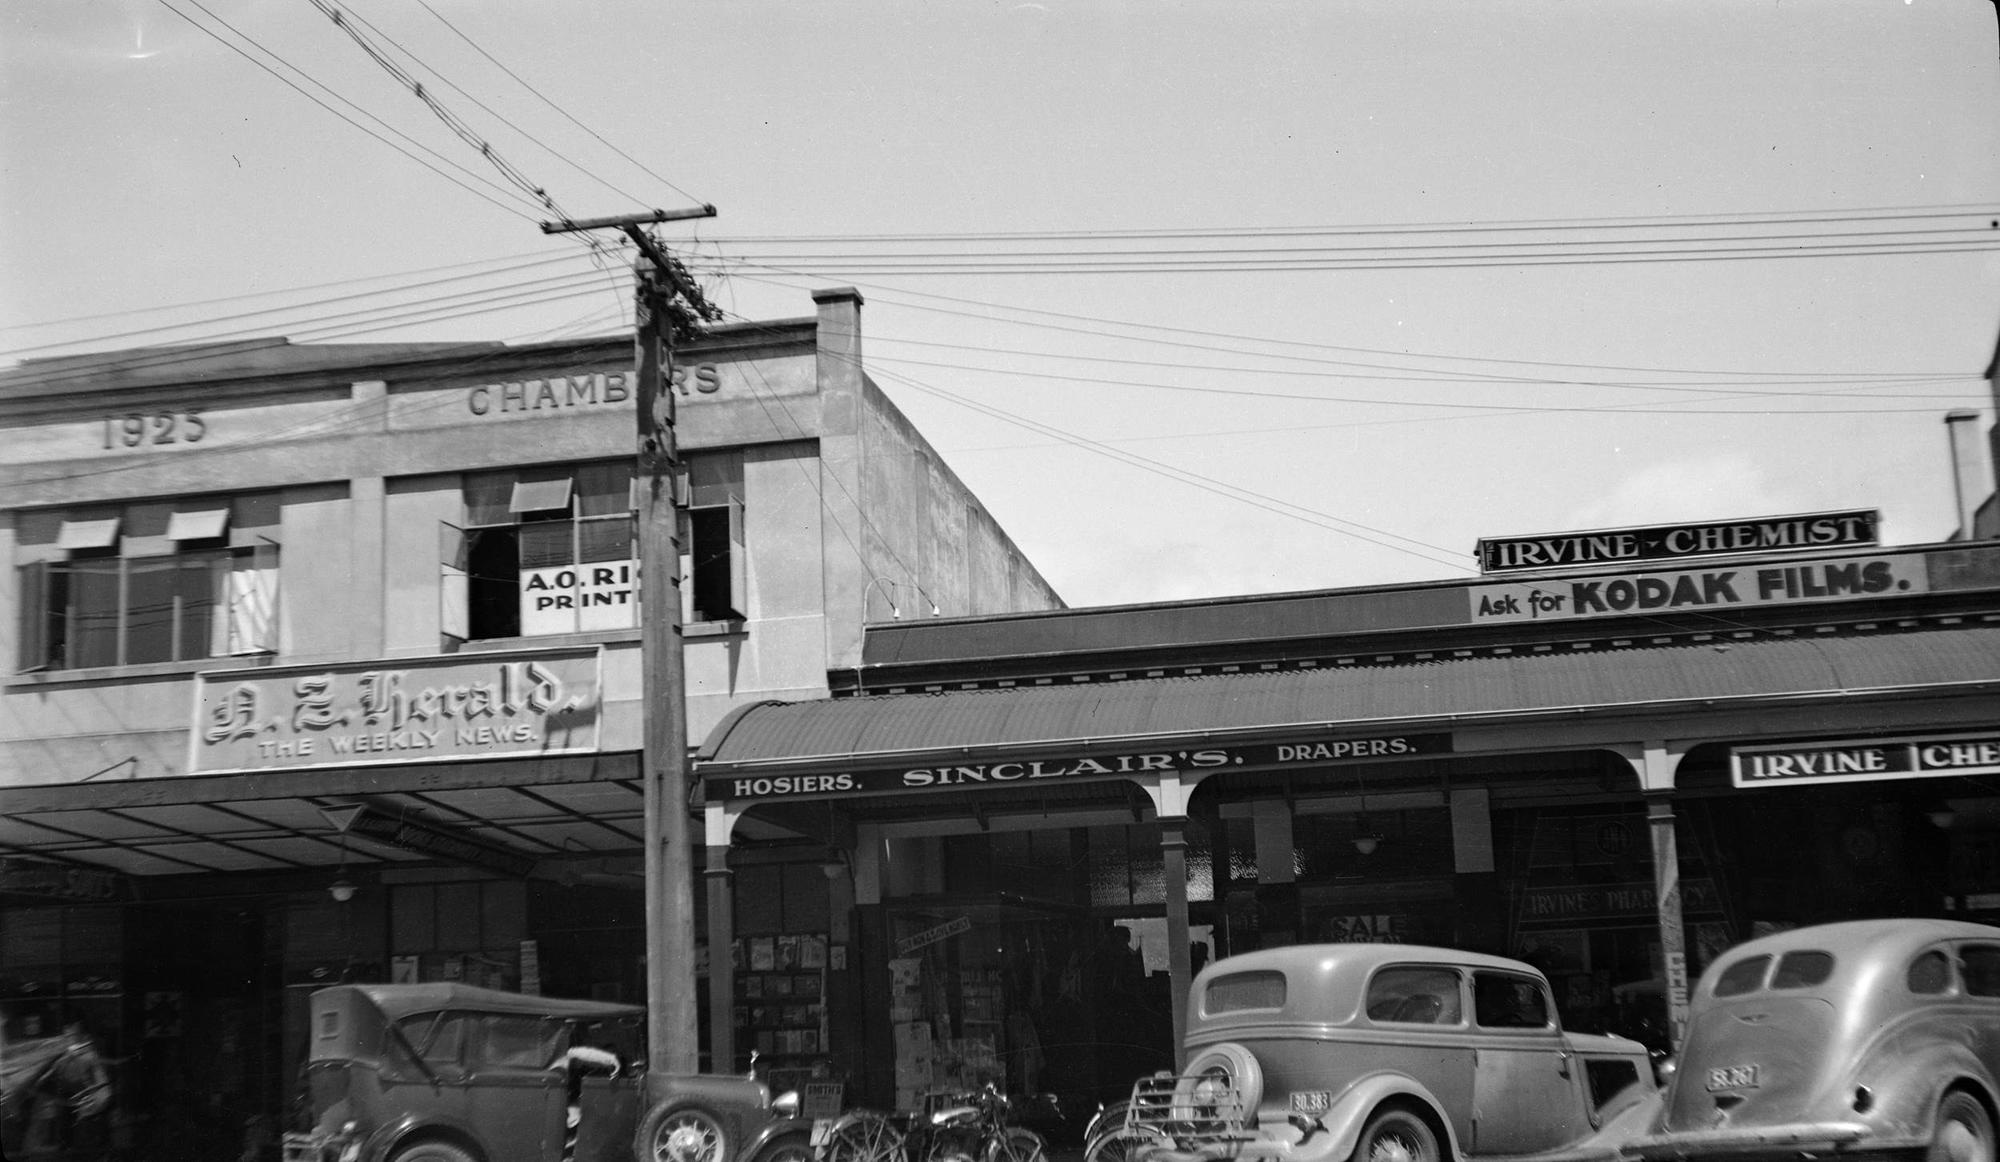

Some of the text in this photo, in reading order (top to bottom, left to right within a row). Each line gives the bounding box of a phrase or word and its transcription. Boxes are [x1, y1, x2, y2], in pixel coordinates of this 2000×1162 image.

[468, 361, 721, 416] CHAMBRS
[103, 408, 206, 450] 1925
[1498, 516, 1865, 567] IRVINE CHEMIST
[1478, 561, 1911, 619] Ask for KODAK FILMS.
[259, 723, 538, 760] THE WEEKLY NEWS.
[733, 737, 1417, 797] HOSIERS. SINCLAIR'S. DRAPERS.
[1752, 748, 1888, 778] IRVINE
[1606, 886, 1708, 910] PHARCY
[1330, 914, 1408, 937] SALE
